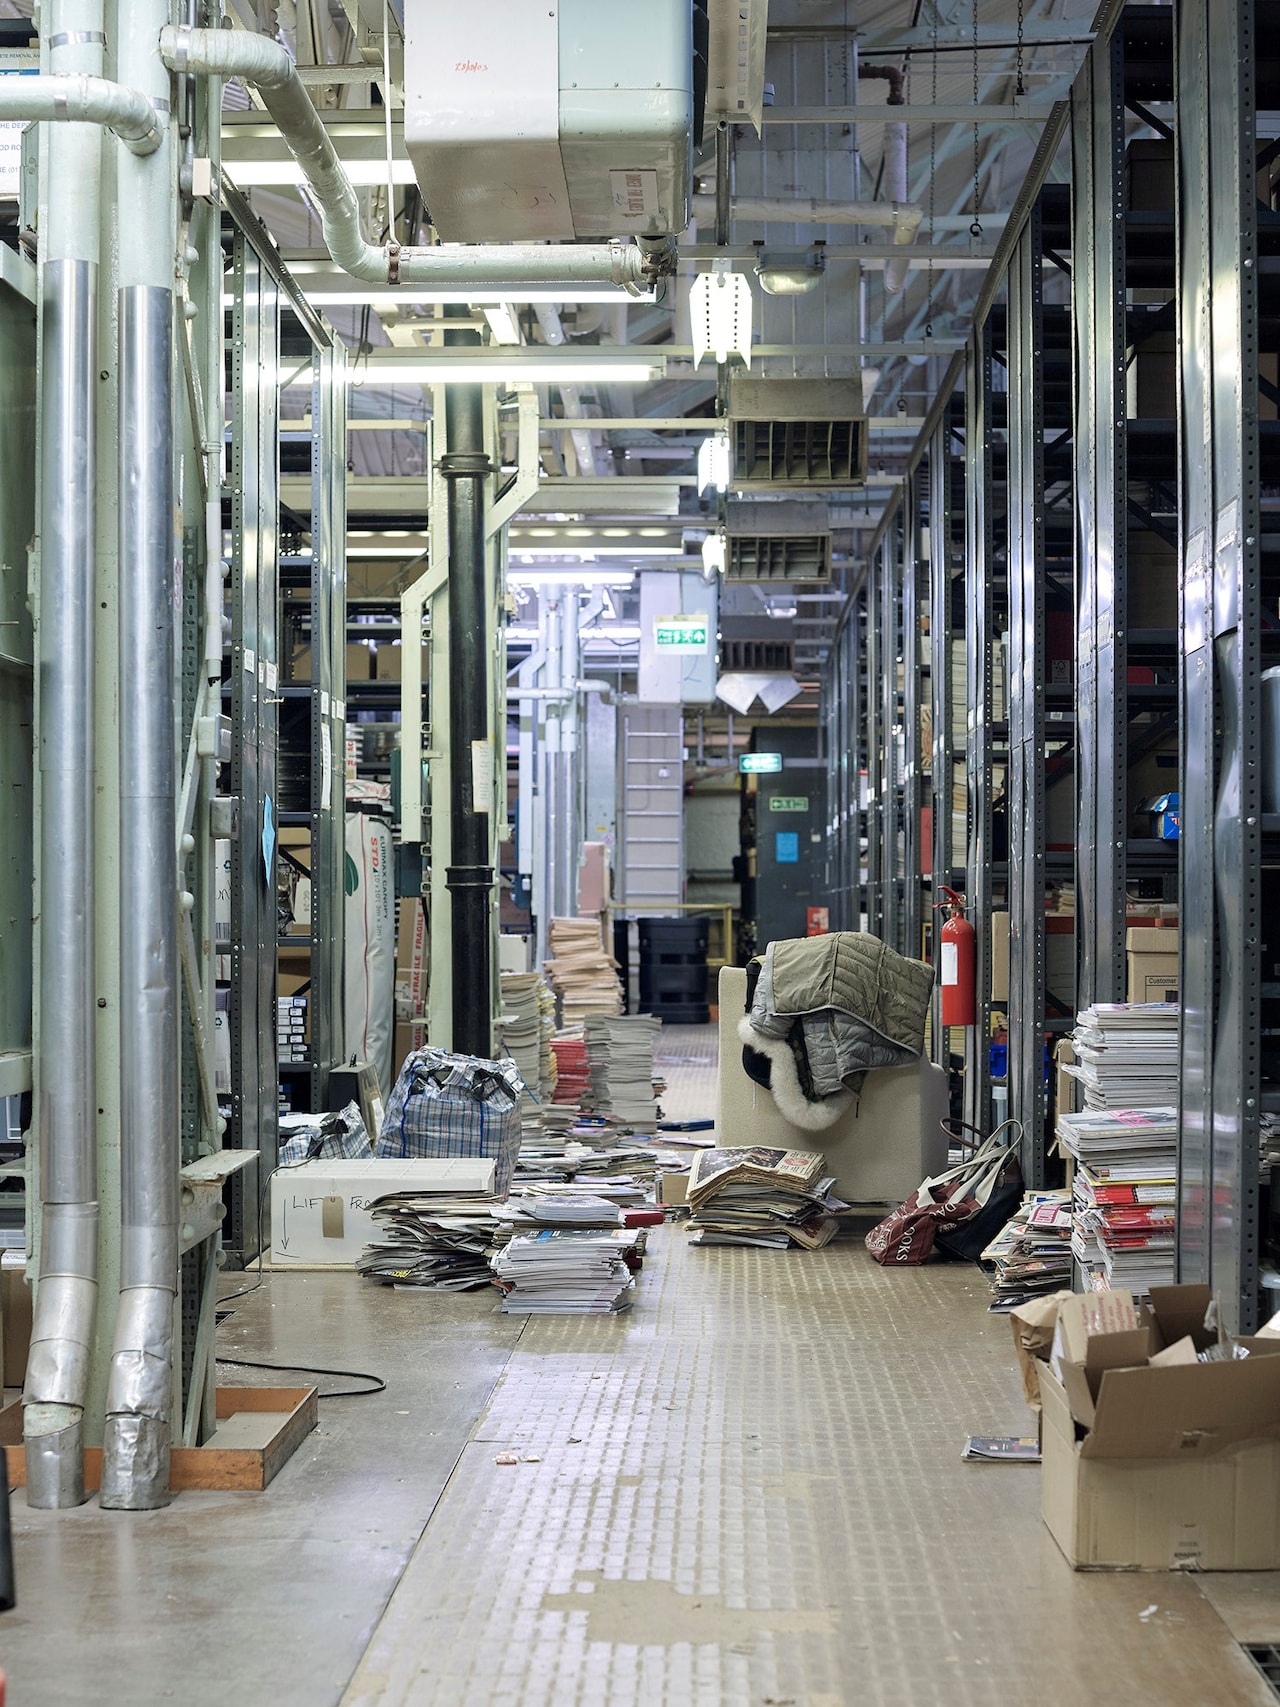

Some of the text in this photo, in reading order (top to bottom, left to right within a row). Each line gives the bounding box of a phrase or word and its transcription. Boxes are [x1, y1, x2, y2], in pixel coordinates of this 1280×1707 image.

[370, 837, 379, 867] STD
[416, 912, 424, 949] FRAGILE
[293, 1195, 323, 1209] LIF
